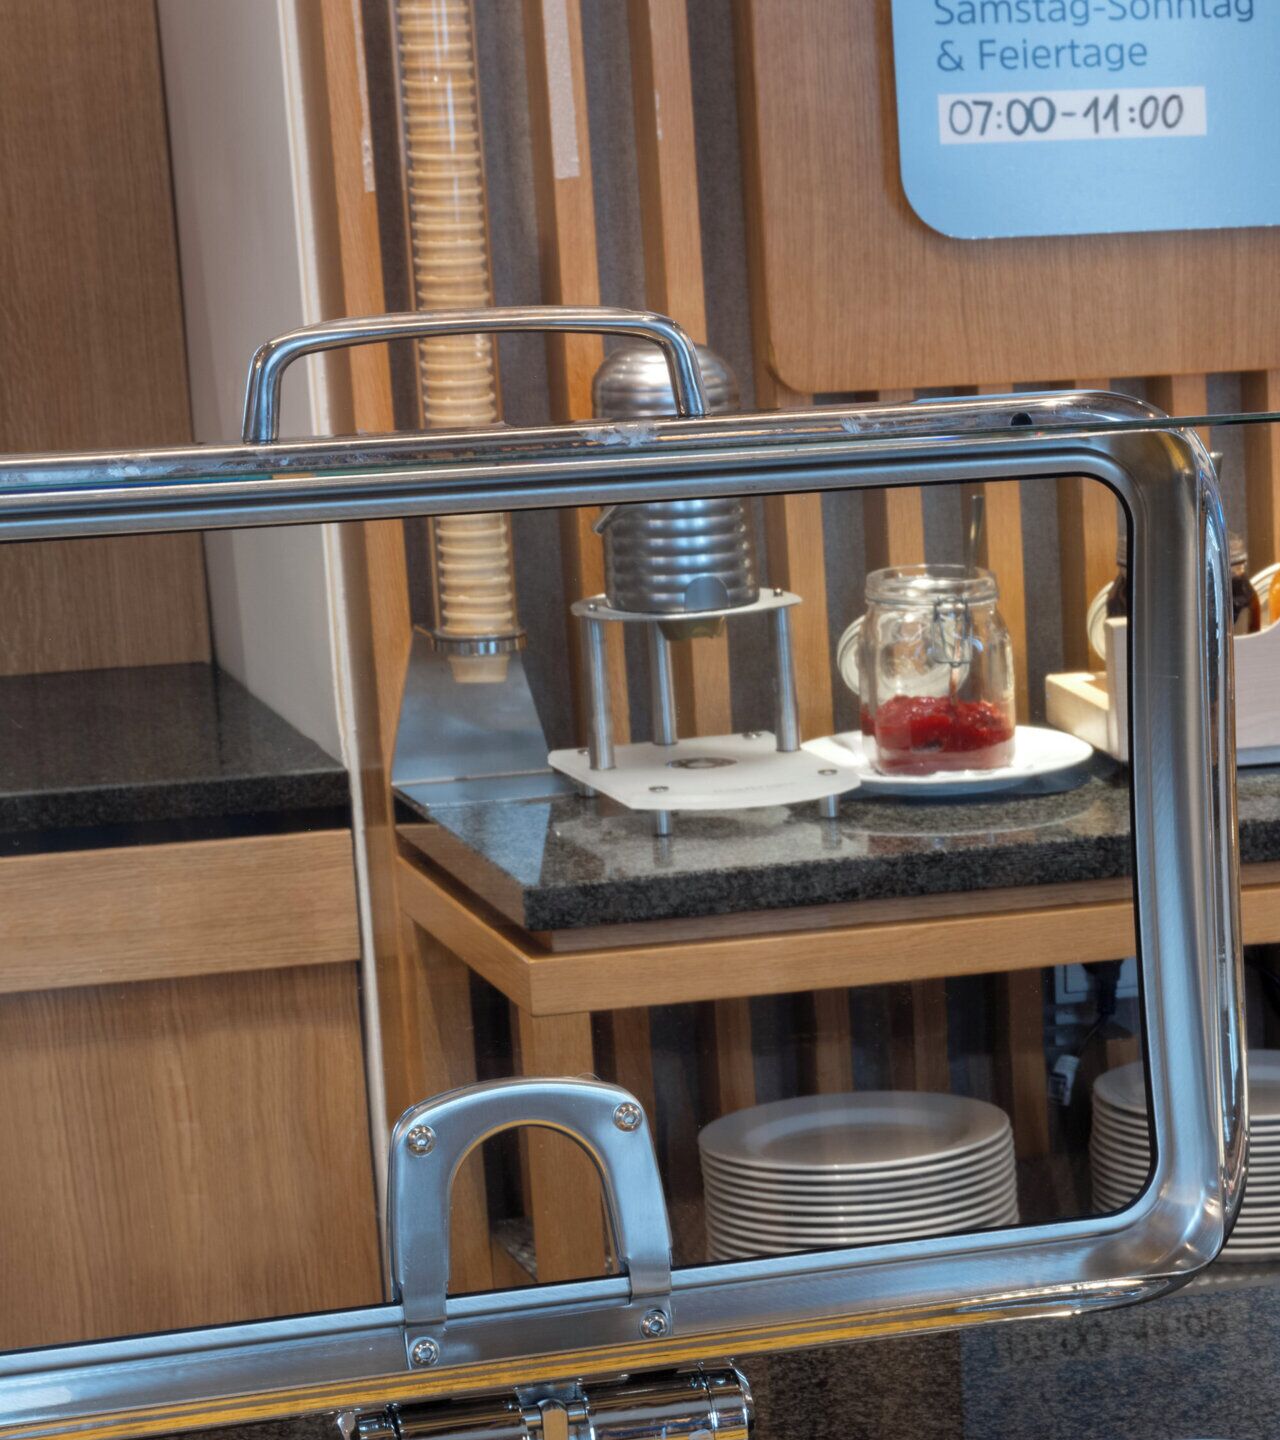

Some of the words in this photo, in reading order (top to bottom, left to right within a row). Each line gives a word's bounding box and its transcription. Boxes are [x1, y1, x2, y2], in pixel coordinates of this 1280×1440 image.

[934, 0, 1254, 26] Samstag-Sonntag
[937, 40, 964, 72] &
[979, 39, 1148, 72] Feiertage
